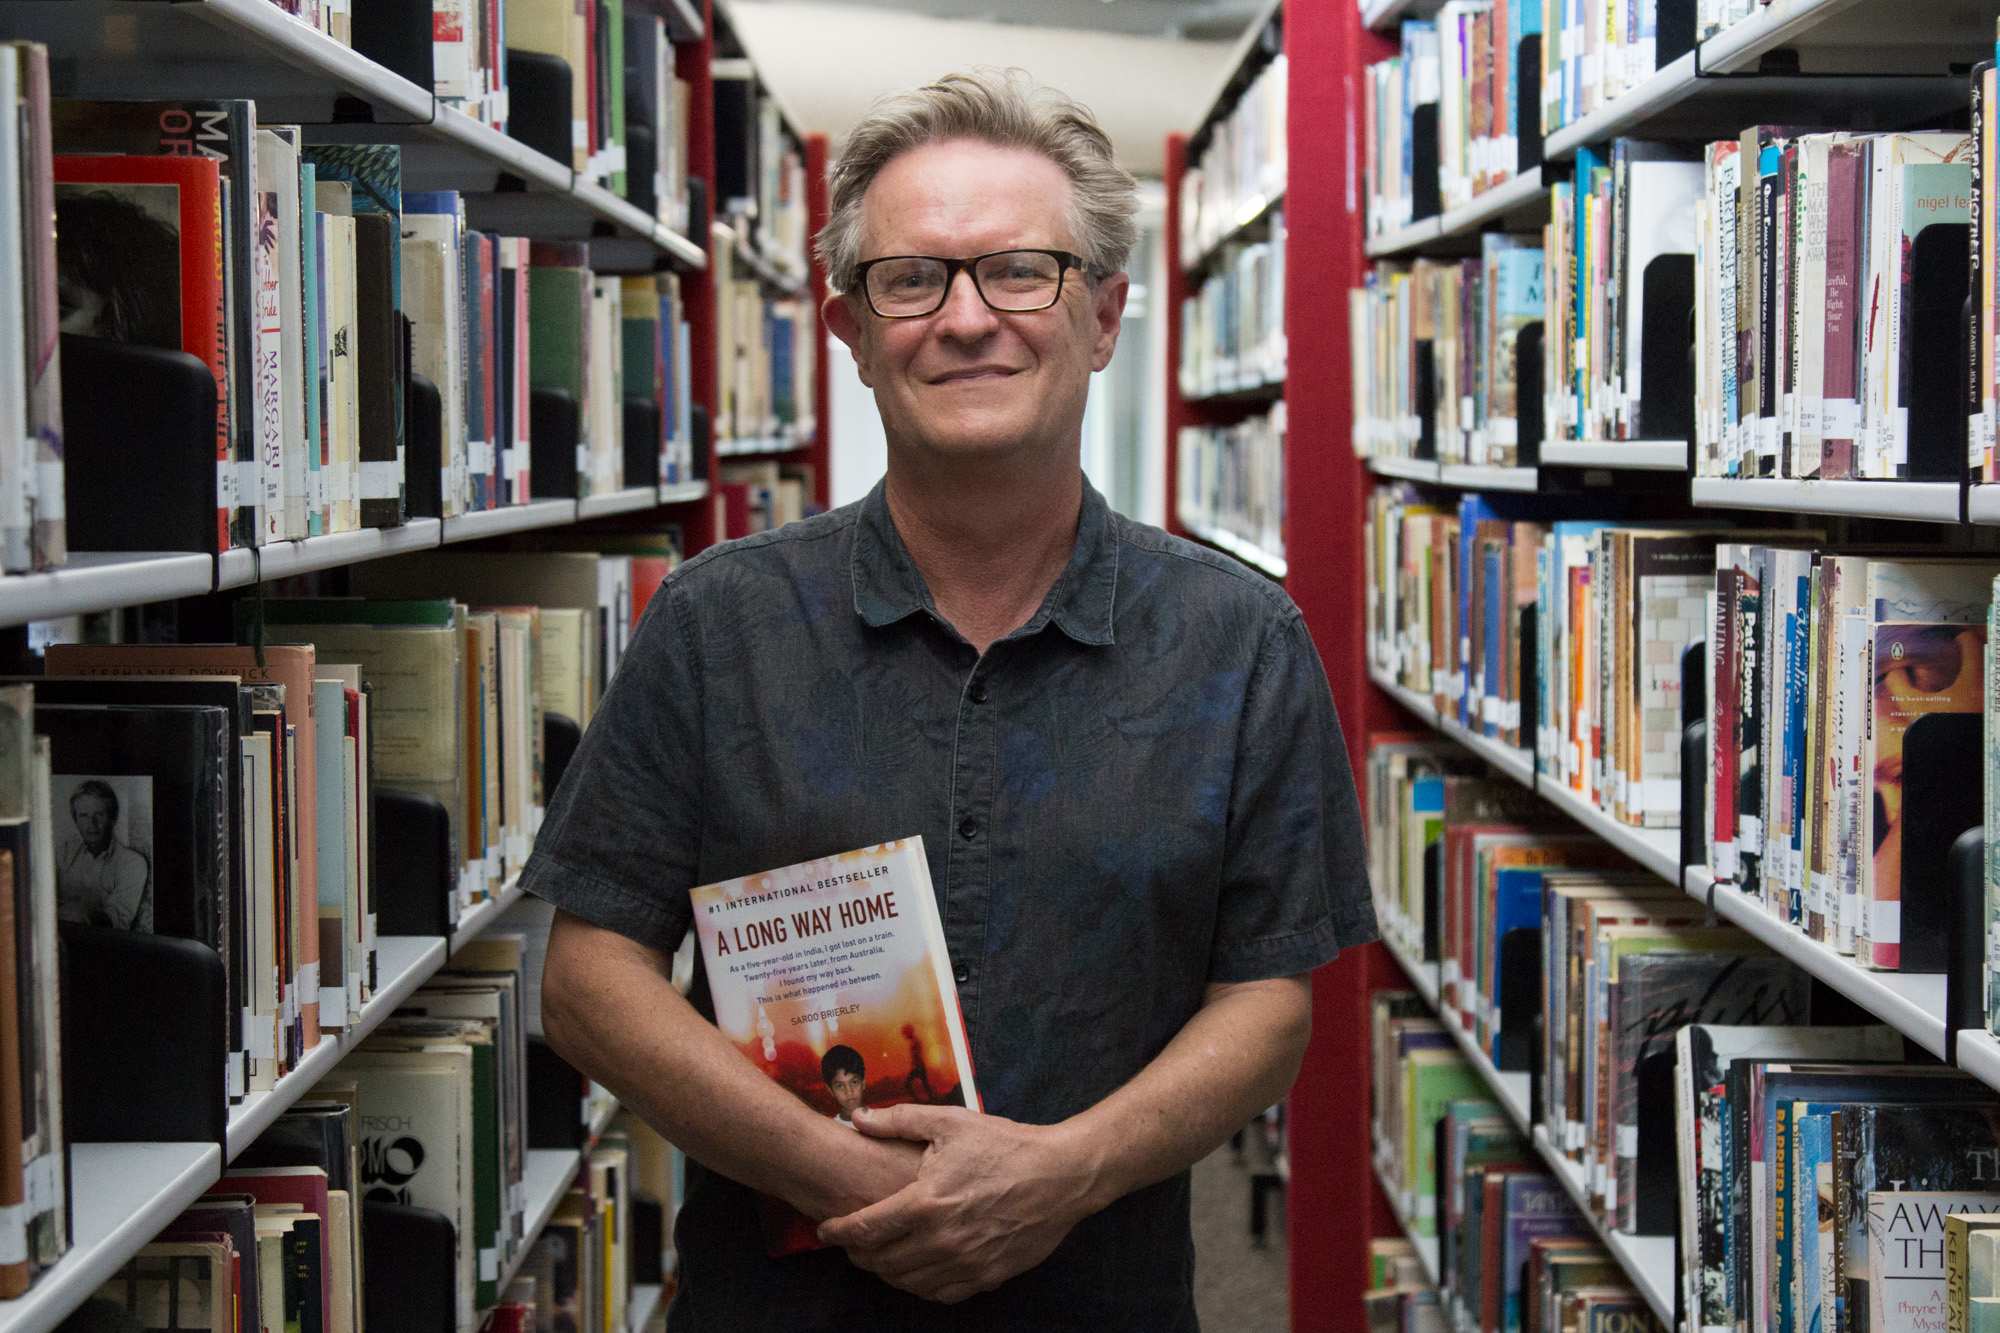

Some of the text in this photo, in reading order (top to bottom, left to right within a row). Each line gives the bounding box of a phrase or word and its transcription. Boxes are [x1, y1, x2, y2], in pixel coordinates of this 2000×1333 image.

[1917, 194, 1949, 211] nigel
[1724, 168, 1736, 277] FORTUNE
[1970, 187, 1980, 270] MOTHER
[1744, 612, 1757, 718] Pat Flower
[708, 866, 889, 914] #1 INTERNATIONAL BESTSELLER
[718, 892, 899, 957] A LONG WAY HOME
[730, 965, 739, 973] As
[746, 952, 794, 970] five-year-old
[804, 947, 824, 957] India,
[829, 943, 841, 953] got
[843, 939, 856, 949] lost
[858, 937, 867, 945] on
[874, 931, 895, 941] train.
[744, 968, 786, 982] Twenty-five
[788, 964, 809, 975] years
[830, 954, 848, 964] from
[849, 946, 885, 959] Australia.
[757, 996, 774, 1004] This
[784, 990, 800, 1000] what
[802, 982, 839, 996] happened
[783, 976, 805, 986] found
[806, 974, 817, 982] my
[819, 971, 834, 980] way
[835, 966, 855, 976] back.
[791, 1004, 861, 1026] SAROO BRIERLEY
[1775, 1109, 1786, 1191] BARRIER
[1775, 1196, 1785, 1240] REEF
[1894, 1238, 1944, 1269] TH
[1931, 1290, 1941, 1301] A
[1947, 1230, 1958, 1333] KENEA
[1898, 1301, 1937, 1316] Phryne
[1912, 1317, 1946, 1333] Myste
